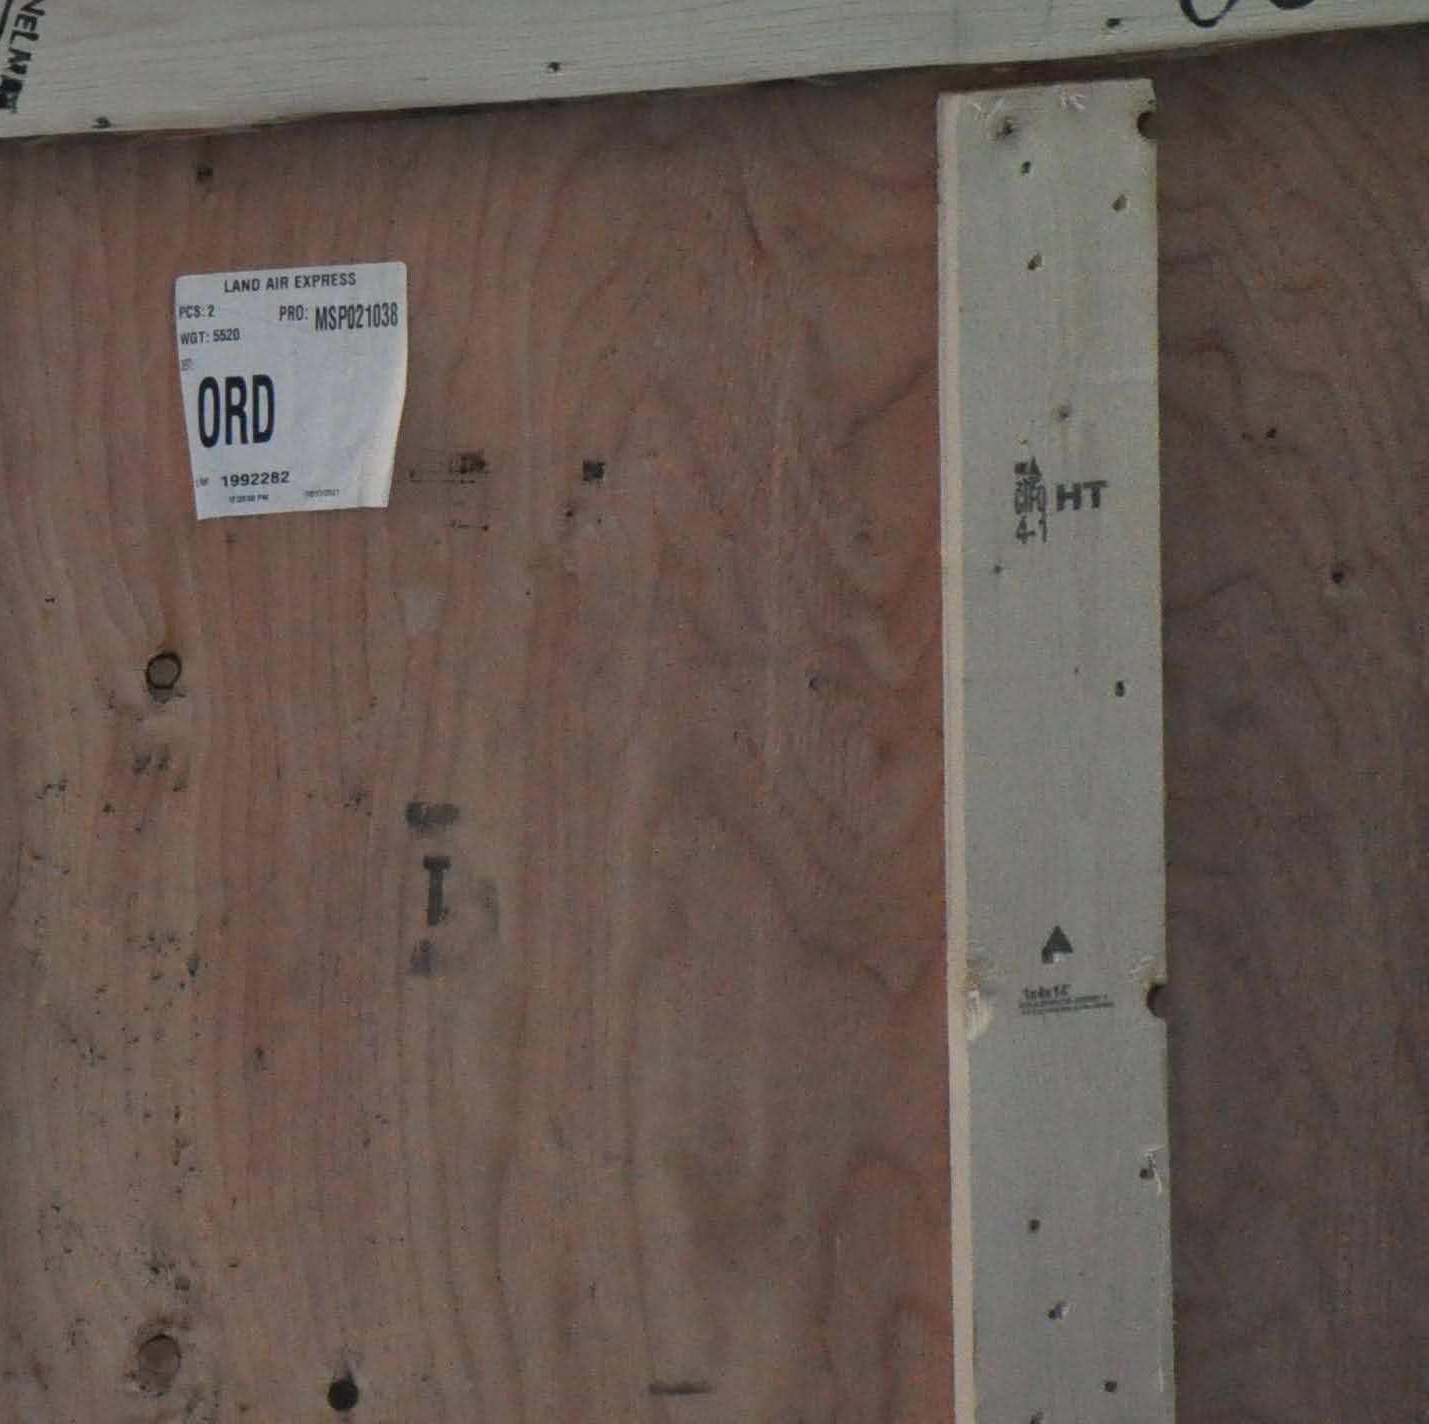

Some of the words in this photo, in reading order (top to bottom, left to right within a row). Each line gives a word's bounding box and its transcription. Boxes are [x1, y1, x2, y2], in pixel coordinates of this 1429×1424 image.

[224, 278, 261, 293] LAND
[265, 277, 289, 289] AIR
[294, 272, 357, 288] EXPRESS
[179, 305, 206, 319] PCS:
[208, 305, 215, 318] 2
[279, 305, 309, 321] PRO:
[315, 302, 399, 332] MSP021038
[180, 332, 211, 345] WGT:
[213, 328, 241, 342] 5520
[198, 374, 276, 449] ORD
[1055, 480, 1108, 512] HT
